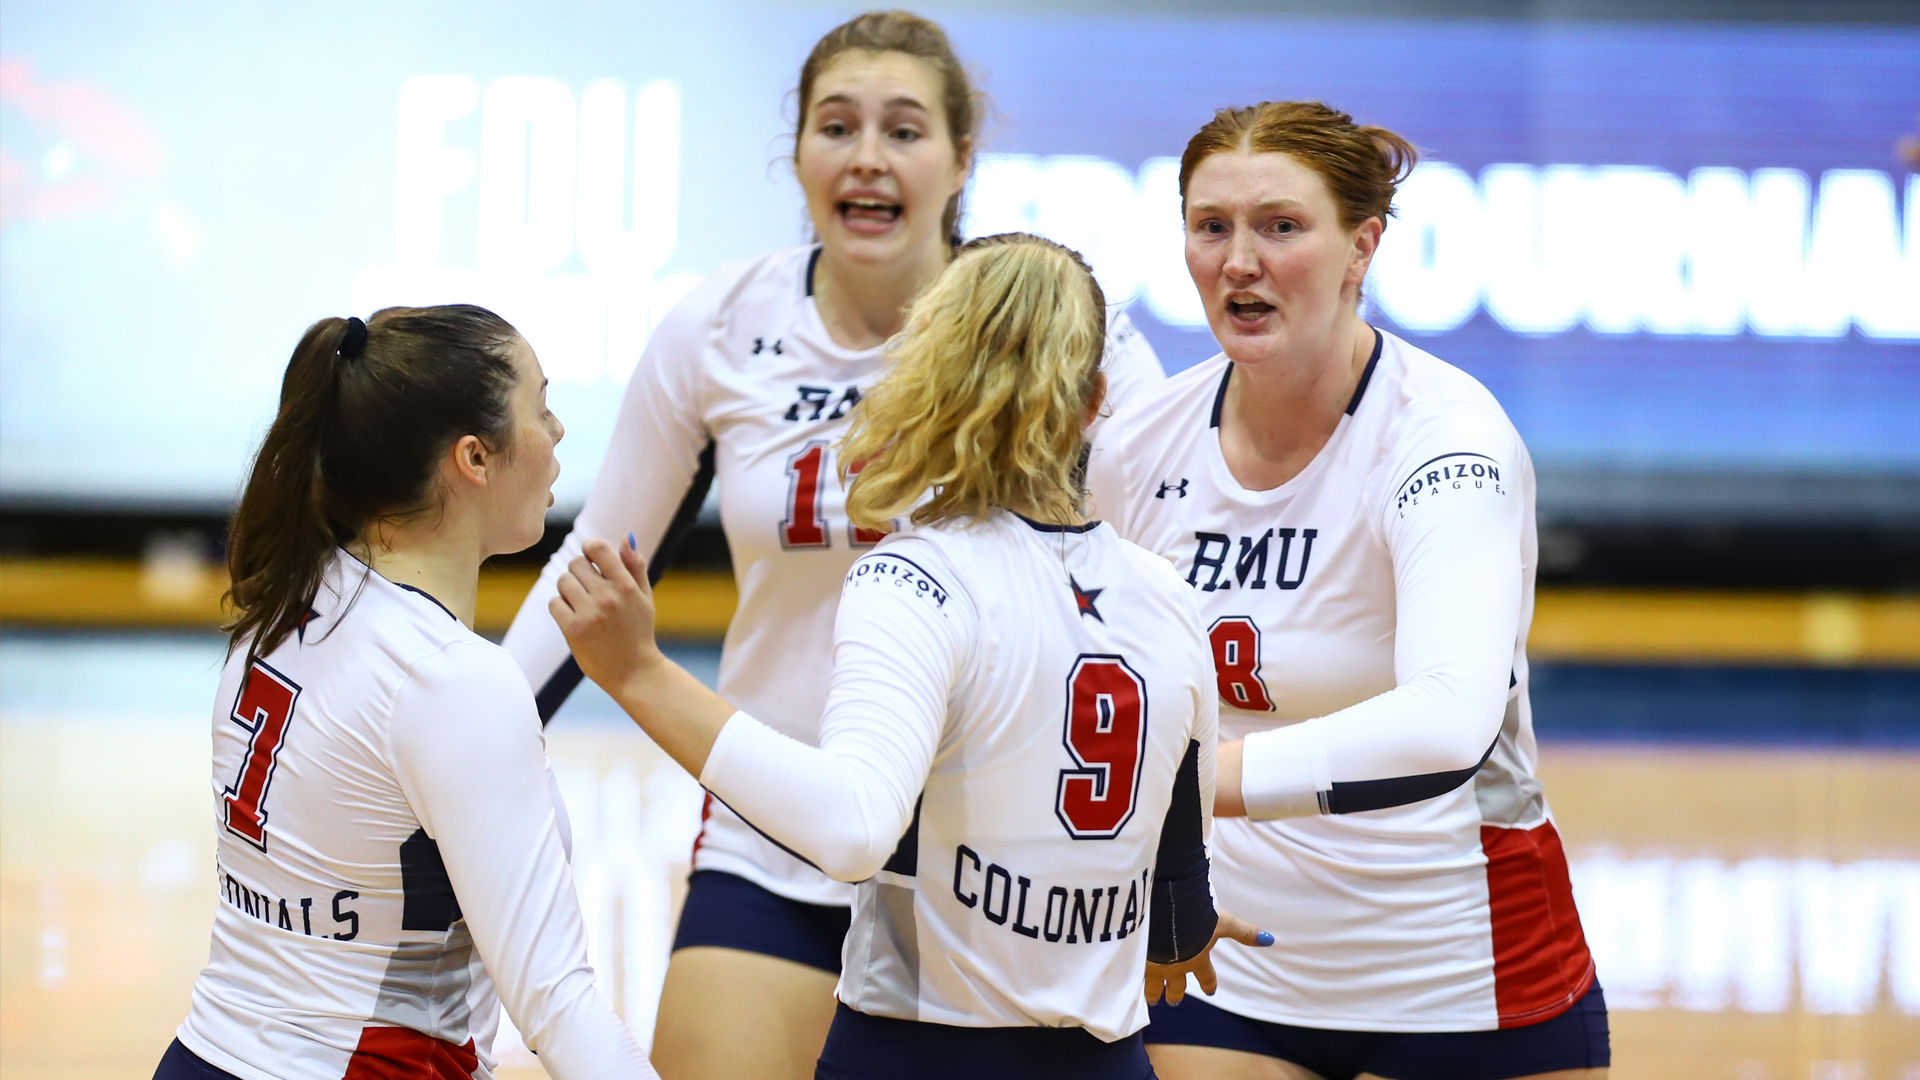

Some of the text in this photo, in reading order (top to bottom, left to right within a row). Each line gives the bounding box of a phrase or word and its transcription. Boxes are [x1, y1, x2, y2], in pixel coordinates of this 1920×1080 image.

[396, 73, 682, 275] FDU
[1376, 165, 1919, 335] OURNA
[779, 440, 900, 551] 1
[1398, 463, 1500, 509] HORIZON
[1400, 481, 1500, 519] LEAGUE
[845, 562, 947, 606] HORIZON
[1186, 528, 1318, 592] RMU
[1207, 615, 1277, 712] 8
[221, 655, 303, 854] 7
[1055, 653, 1148, 840] 9
[217, 852, 359, 941] ONIALS
[953, 844, 1149, 944] COLONIAL
